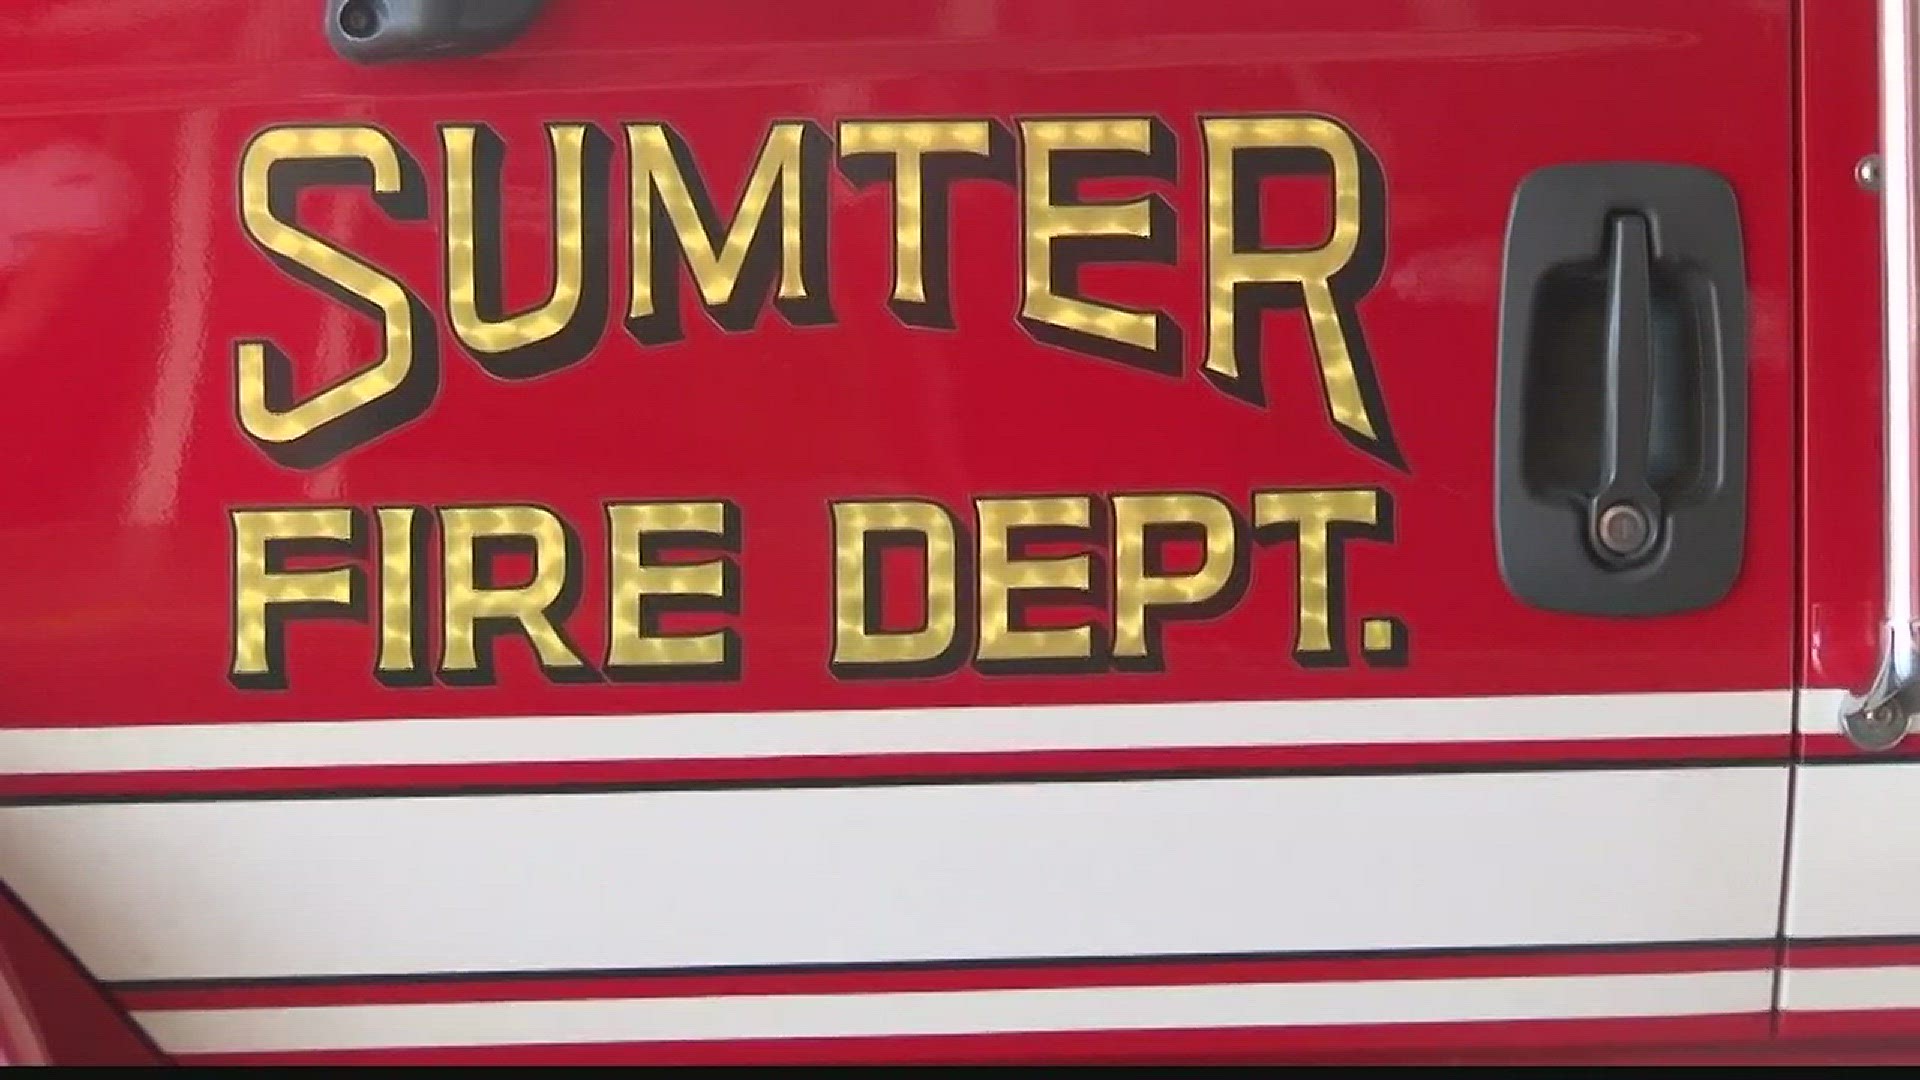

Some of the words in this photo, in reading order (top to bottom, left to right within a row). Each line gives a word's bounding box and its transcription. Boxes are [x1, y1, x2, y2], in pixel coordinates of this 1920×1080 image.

[235, 115, 1384, 450] SUMTER
[231, 501, 733, 677] FIRE
[830, 488, 1396, 667] DEPT.
